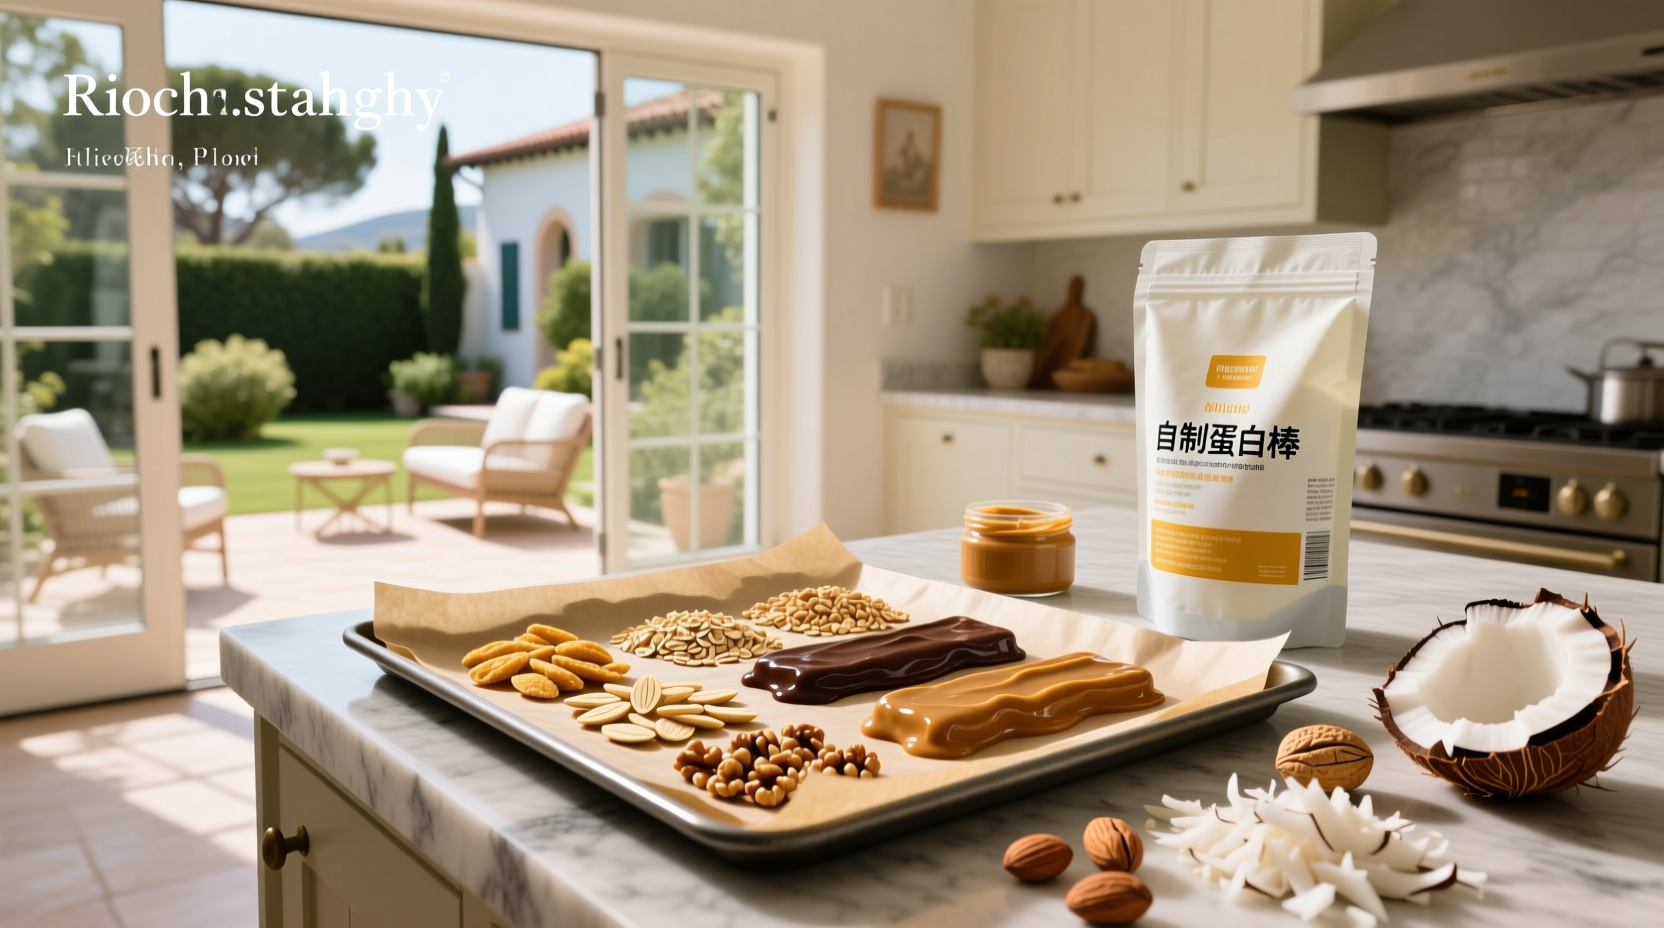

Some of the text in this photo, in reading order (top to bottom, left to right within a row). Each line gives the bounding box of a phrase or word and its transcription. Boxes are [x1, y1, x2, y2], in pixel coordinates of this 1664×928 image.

[1156, 420, 1300, 460] 自制蛋白棒
